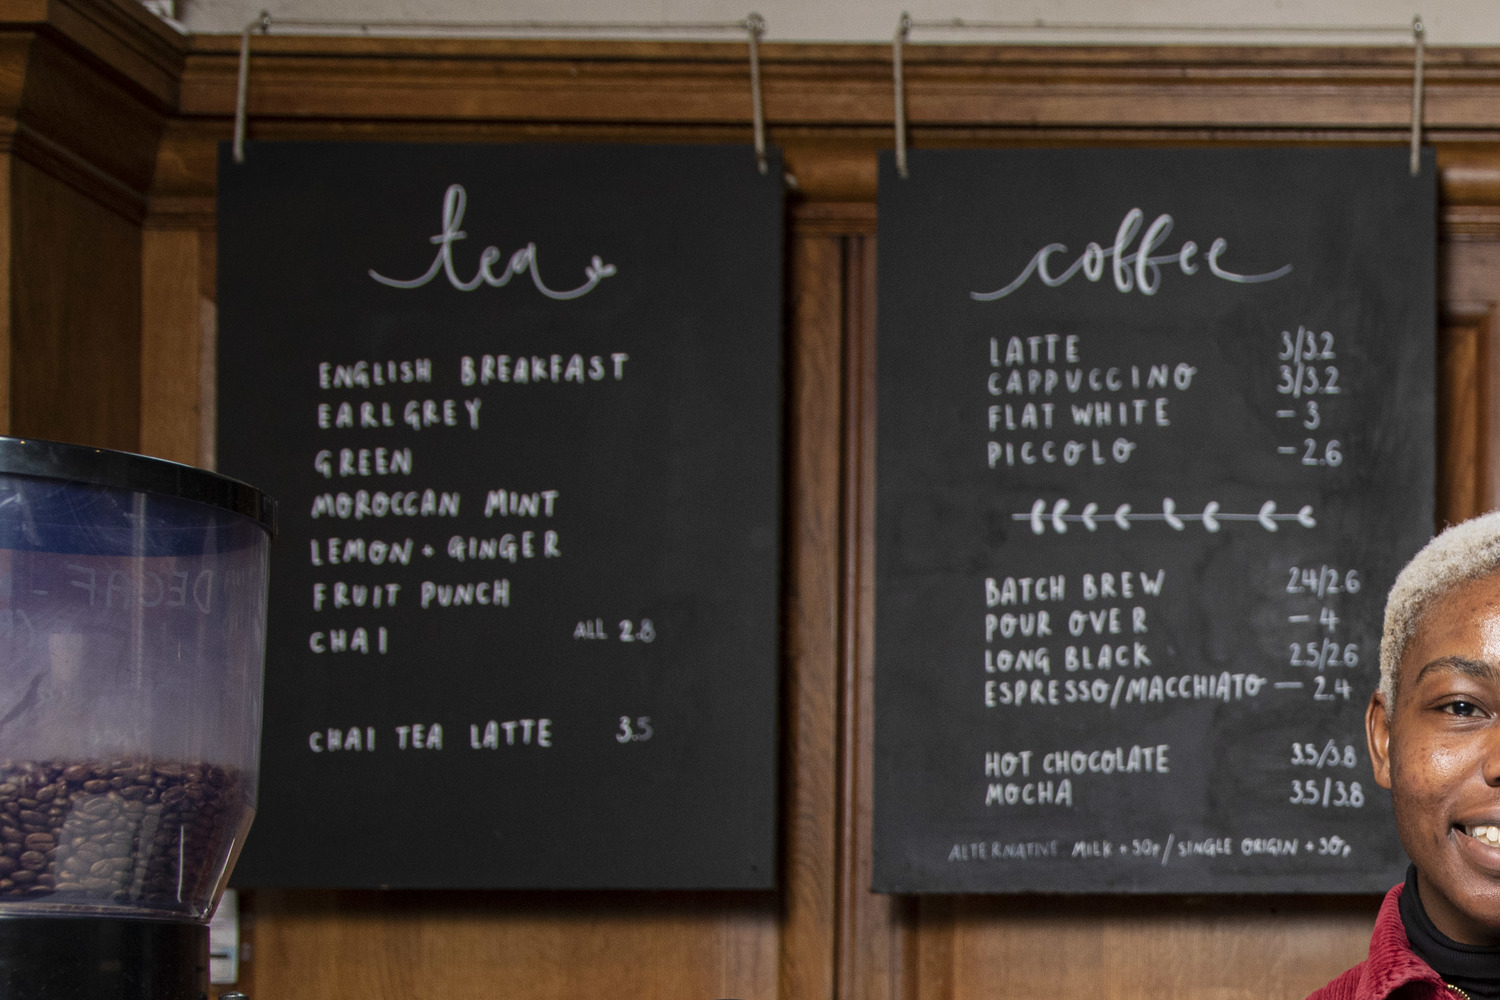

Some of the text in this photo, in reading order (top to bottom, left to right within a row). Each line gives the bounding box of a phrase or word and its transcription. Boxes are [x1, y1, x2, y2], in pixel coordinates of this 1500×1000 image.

[368, 184, 598, 300] tea
[970, 206, 1293, 302] coffee
[990, 325, 1338, 367] LATTE 3/3.2
[318, 352, 628, 389] ENGLISH BREAKFAST
[987, 361, 1344, 399] CAPPUCCINO 3/3.2
[318, 398, 481, 430] EARL GREY
[988, 402, 1054, 431] FLAT
[1071, 397, 1170, 427] WHITE
[1303, 400, 1321, 430] 3
[314, 447, 412, 477] GREEN
[987, 437, 1136, 468] PICCOLO
[1301, 437, 1343, 467] 2.6
[311, 488, 558, 519] MOROCCAN MINT
[310, 537, 414, 566] LEMON
[447, 529, 560, 562] GINGER
[313, 578, 510, 611] FRUIT PUNCH
[984, 574, 1066, 607] BATCH
[1082, 569, 1165, 601] BREW
[309, 626, 388, 654] CHAI
[573, 618, 607, 640] ALL
[985, 610, 1052, 642] POUR
[1068, 606, 1147, 637] OVER
[1319, 607, 1339, 629] 4
[984, 647, 1050, 675] LONG
[1064, 641, 1151, 672] BLACK
[983, 670, 1268, 710] ESPRESSO/MACCHIATO
[1313, 674, 1352, 701] 2.4
[308, 715, 652, 753] CHAI TEA LATTE 3.5
[984, 750, 1032, 777] HOT
[1042, 744, 1169, 775] CHOCOLATE
[985, 778, 1072, 806] MOCHA
[948, 842, 1058, 862] ALTERNATIVE
[1070, 839, 1113, 858] MILK
[1177, 838, 1234, 858] SINGLE
[1240, 837, 1300, 857] ORIGIN
